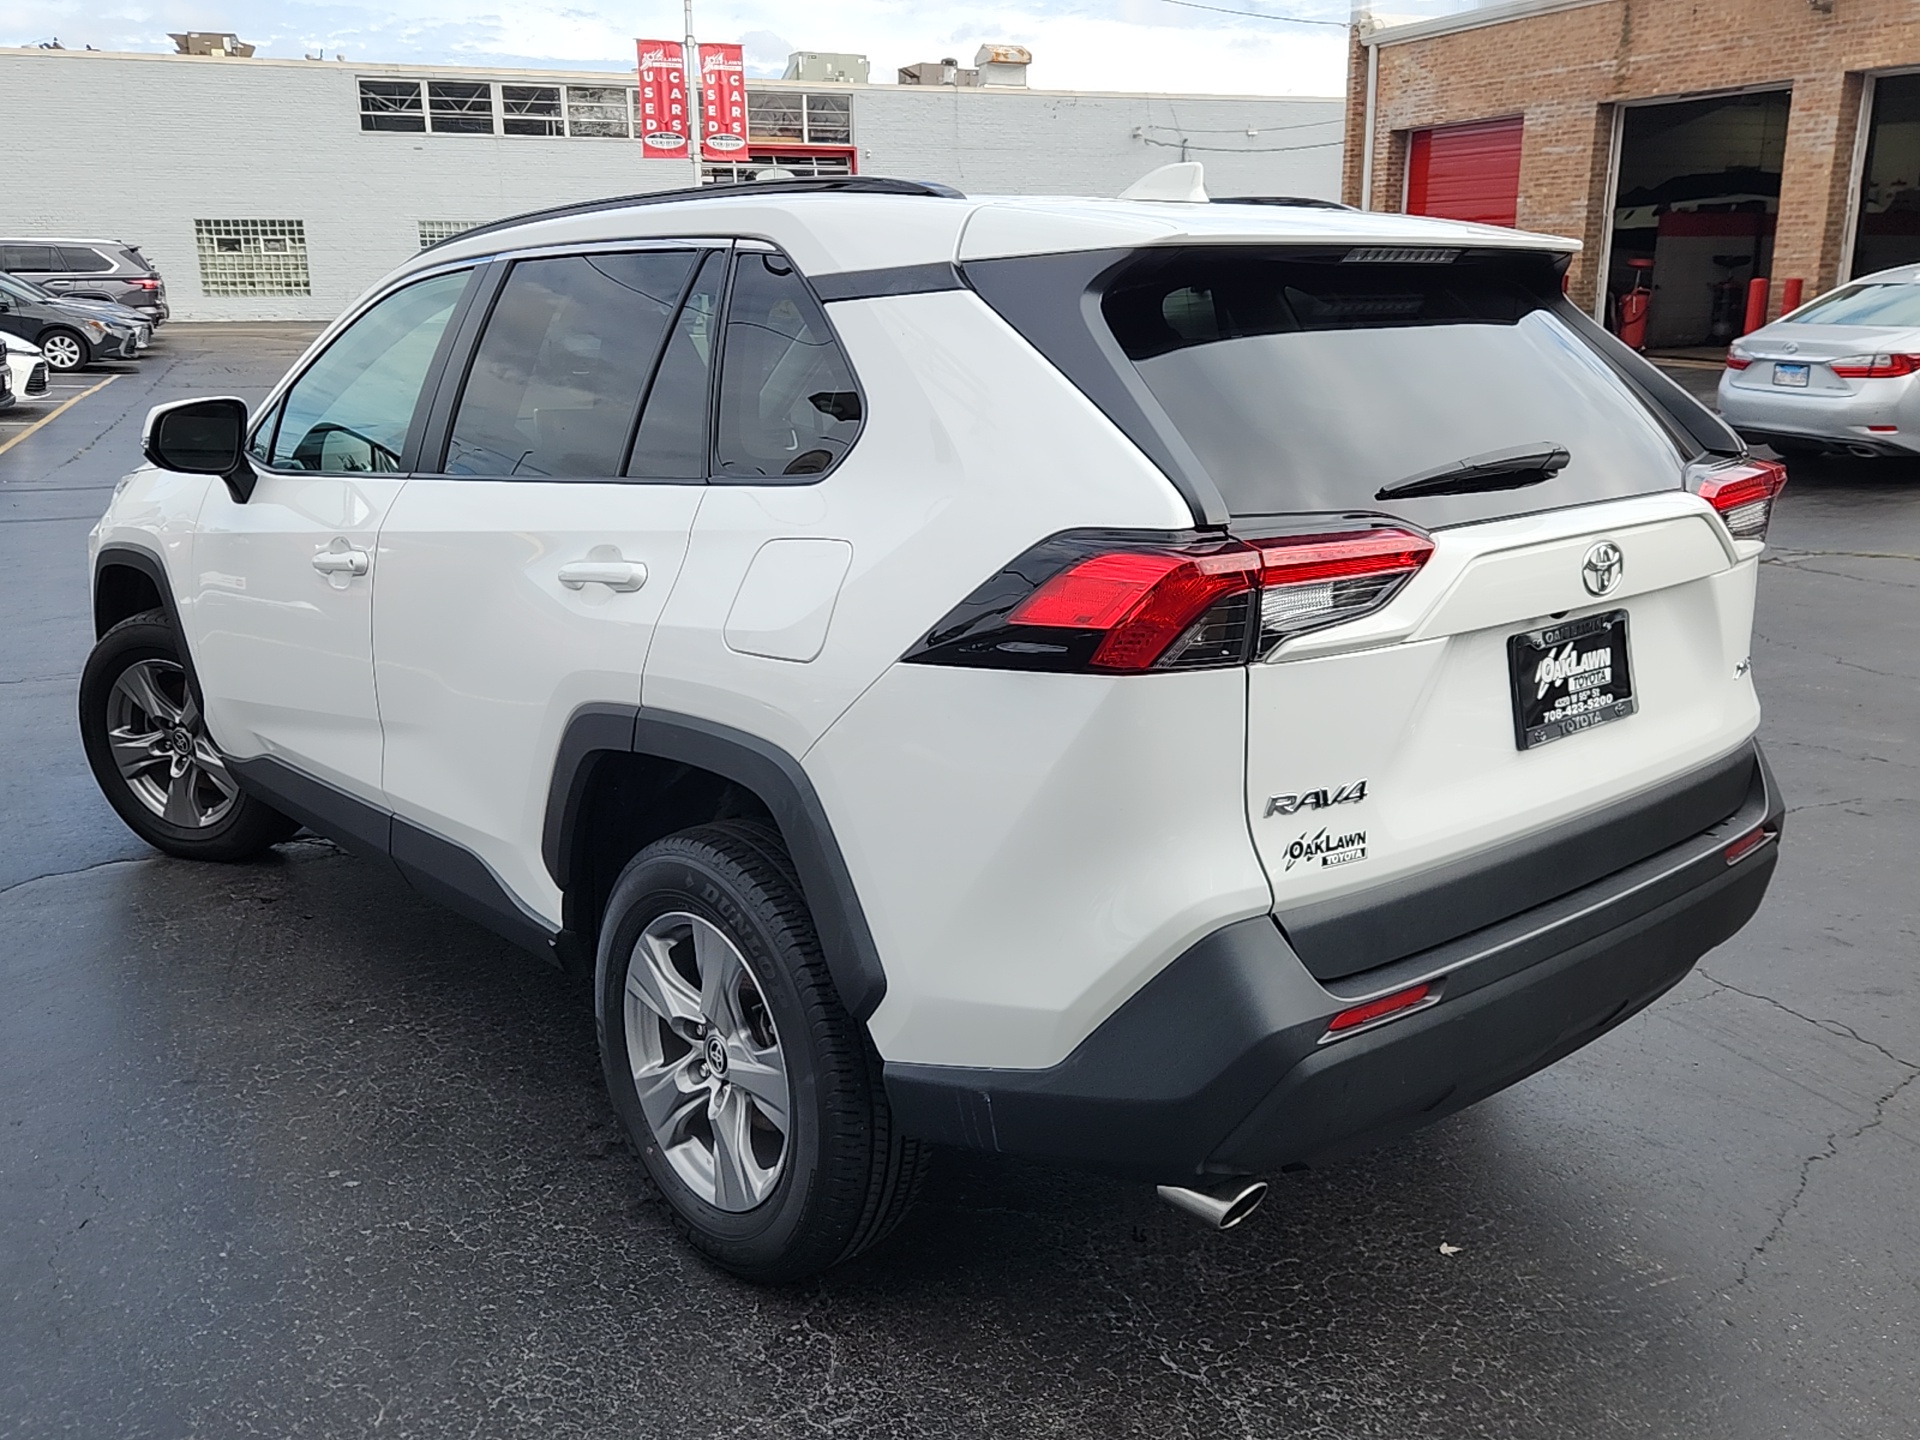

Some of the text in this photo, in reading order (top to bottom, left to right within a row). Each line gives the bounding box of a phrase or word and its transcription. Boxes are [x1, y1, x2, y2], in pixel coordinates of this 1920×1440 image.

[643, 71, 657, 130] USED
[669, 71, 682, 131] CARS
[706, 73, 718, 132] USED
[730, 75, 742, 133] CARS
[1572, 670, 1608, 689] TOYOTA
[1543, 693, 1613, 723] 708-423-5200
[1560, 711, 1602, 734] TOYOTA
[1263, 778, 1368, 818] RAV4
[1325, 849, 1363, 865] TOYOTA
